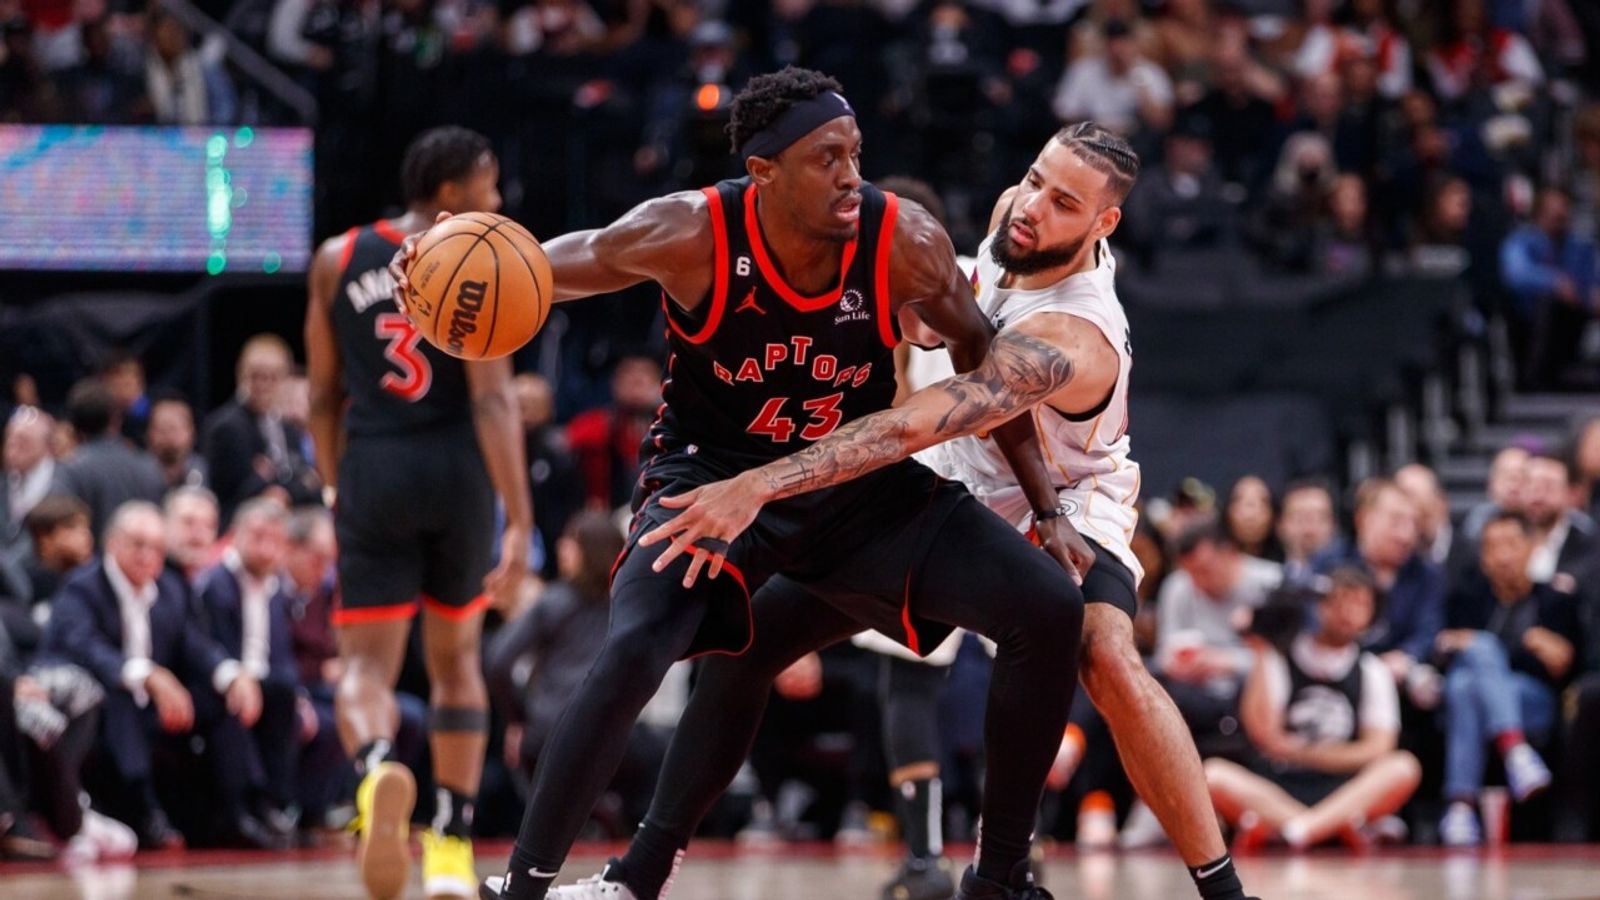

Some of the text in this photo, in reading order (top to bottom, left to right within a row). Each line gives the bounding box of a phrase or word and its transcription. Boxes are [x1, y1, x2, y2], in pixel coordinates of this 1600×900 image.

[736, 256, 751, 277] 6
[447, 280, 488, 354] Wilson
[834, 310, 871, 326] Sun Life
[375, 312, 433, 403] 3
[713, 335, 873, 388] RAPTORS
[746, 391, 844, 443] 43
